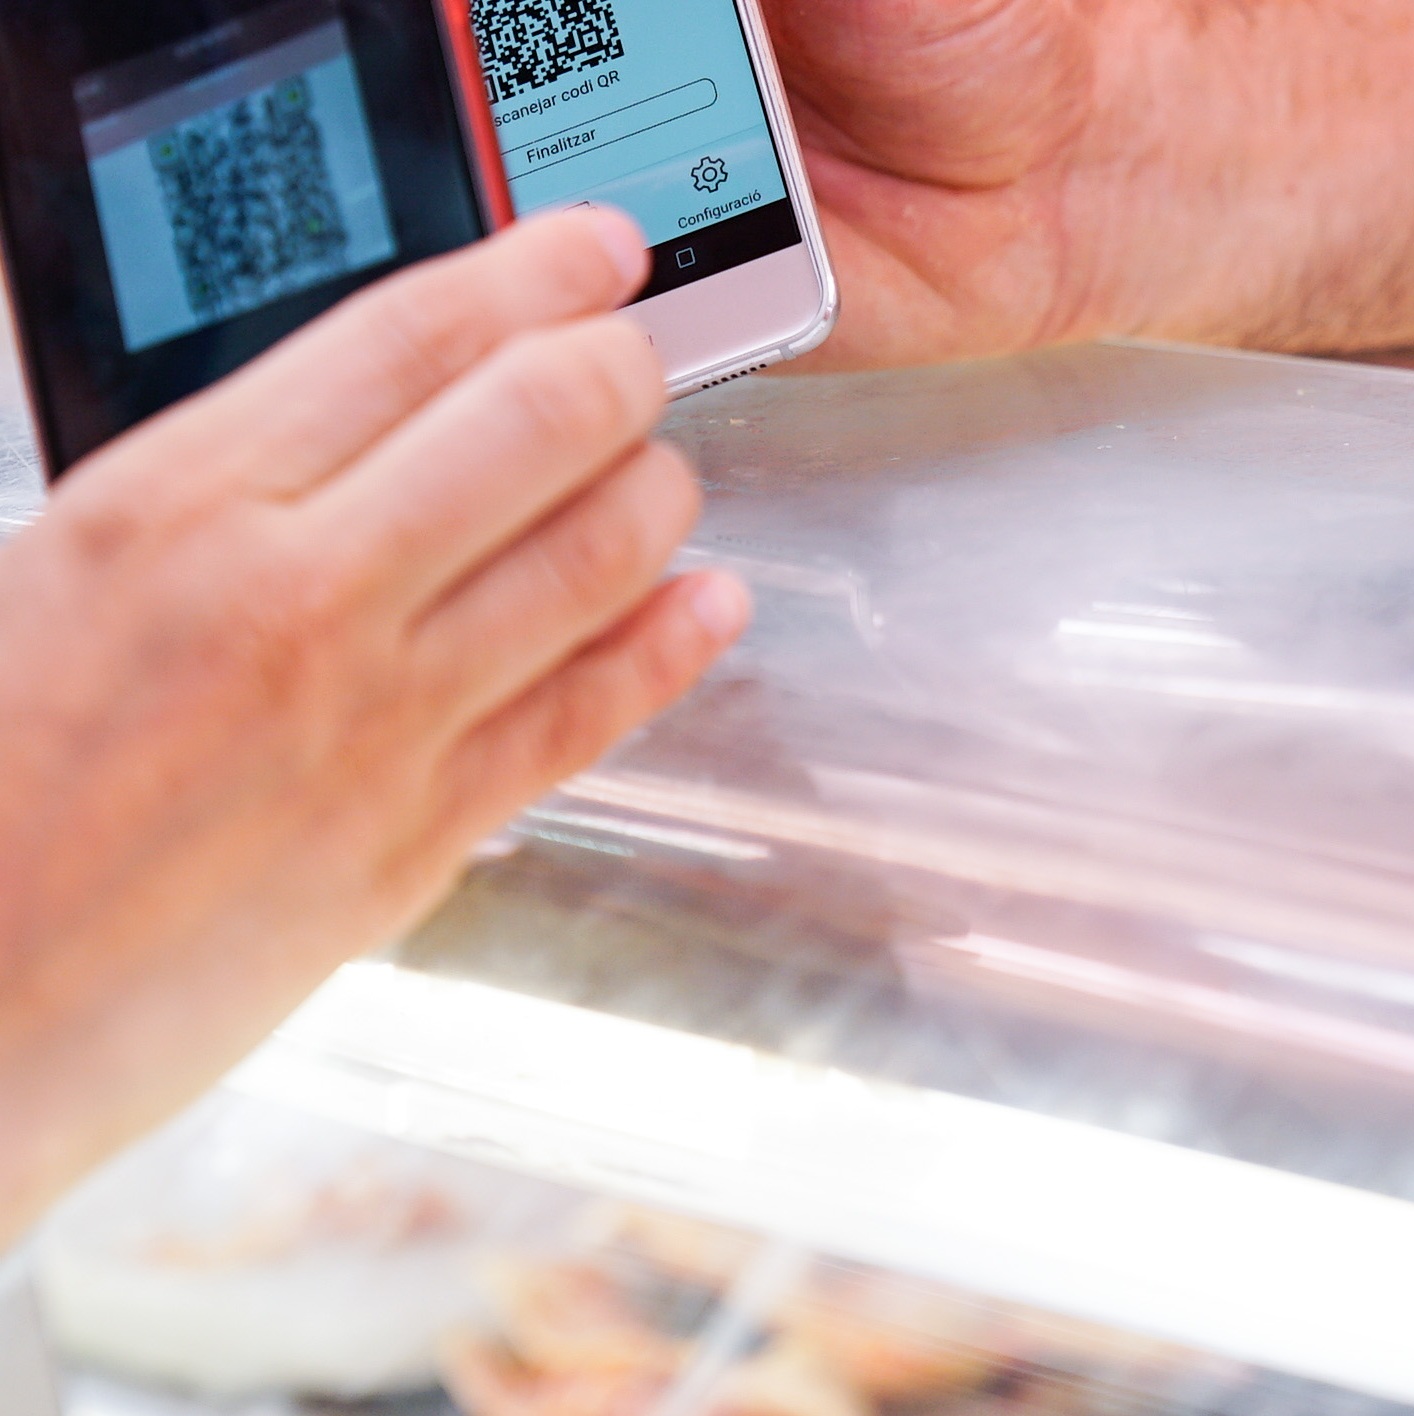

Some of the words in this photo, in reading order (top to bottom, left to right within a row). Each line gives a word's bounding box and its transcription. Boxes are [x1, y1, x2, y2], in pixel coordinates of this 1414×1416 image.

[494, 94, 557, 127] scanejar
[561, 79, 593, 102] codi
[597, 70, 620, 88] QR
[526, 129, 596, 164] Finalitzar
[678, 189, 761, 229] Configuració
